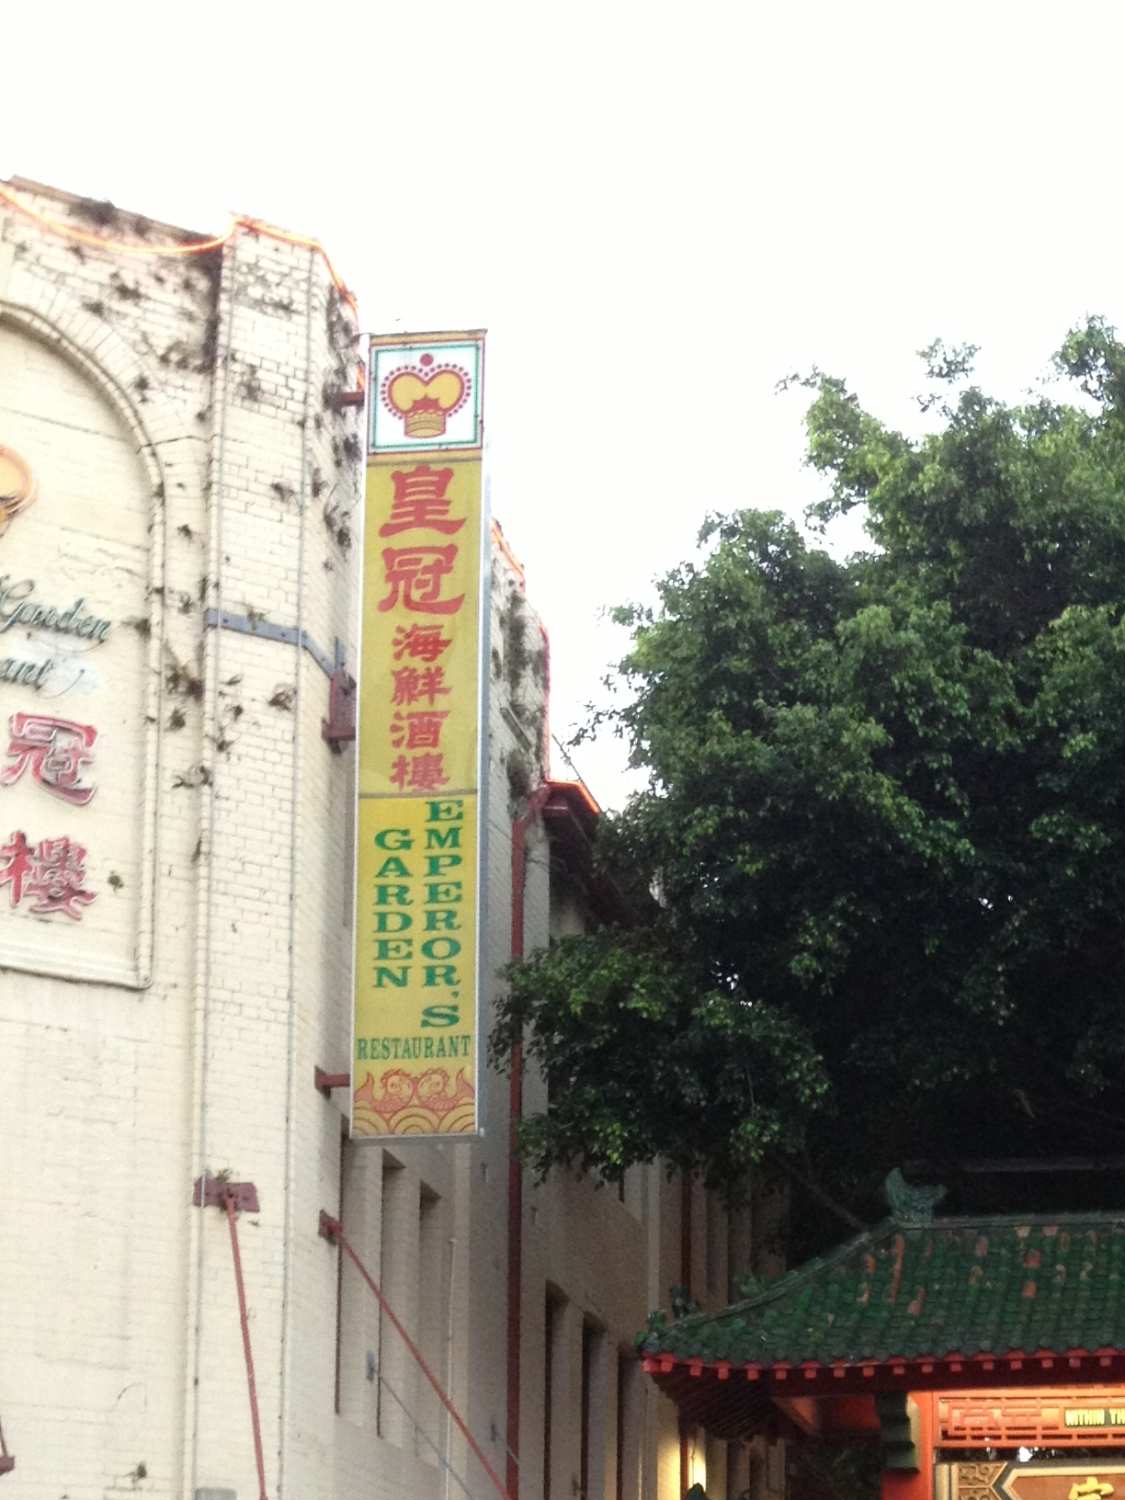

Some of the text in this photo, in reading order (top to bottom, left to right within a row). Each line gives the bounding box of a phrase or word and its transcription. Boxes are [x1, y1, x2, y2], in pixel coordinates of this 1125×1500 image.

[372, 829, 416, 988] GARDEN
[420, 799, 465, 1029] EMPEROR'S
[357, 1035, 472, 1061] RESTAURANT
[1065, 1408, 1105, 1426] WITHIN
